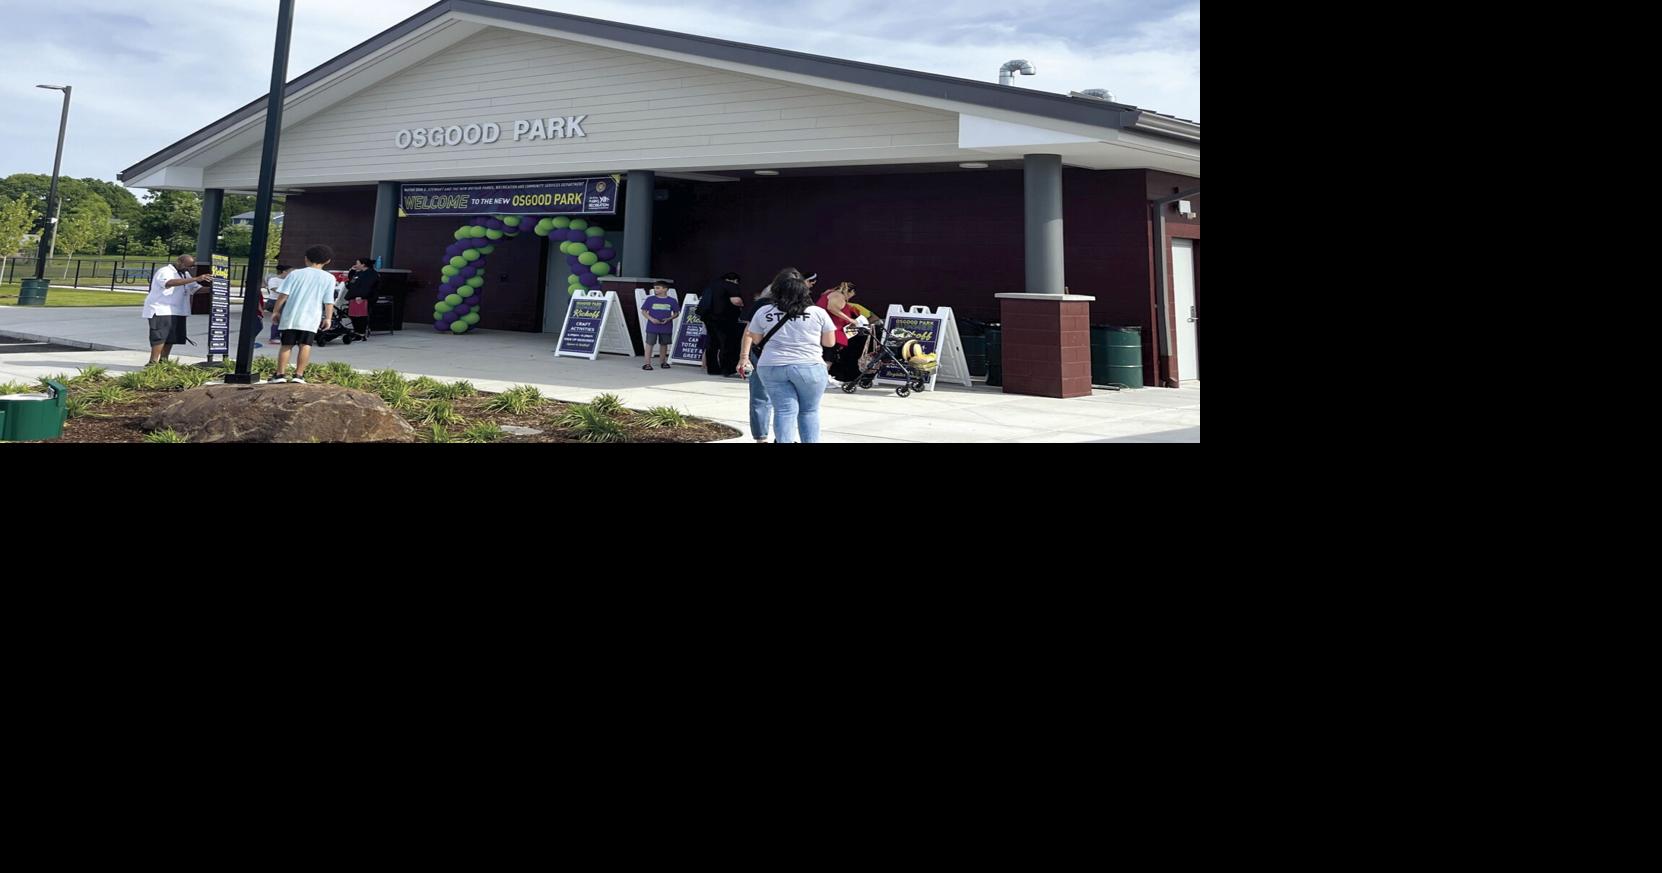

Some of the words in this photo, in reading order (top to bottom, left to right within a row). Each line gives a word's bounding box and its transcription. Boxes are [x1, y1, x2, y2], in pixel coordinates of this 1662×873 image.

[395, 122, 501, 150] OSGOOD
[513, 114, 589, 141] PARK
[404, 194, 470, 210] WELCOME
[494, 197, 511, 205] NEW
[512, 193, 552, 207] OSGOOD
[552, 192, 583, 206] PARK
[573, 309, 600, 319] Kickoff
[765, 312, 811, 322] STFF
